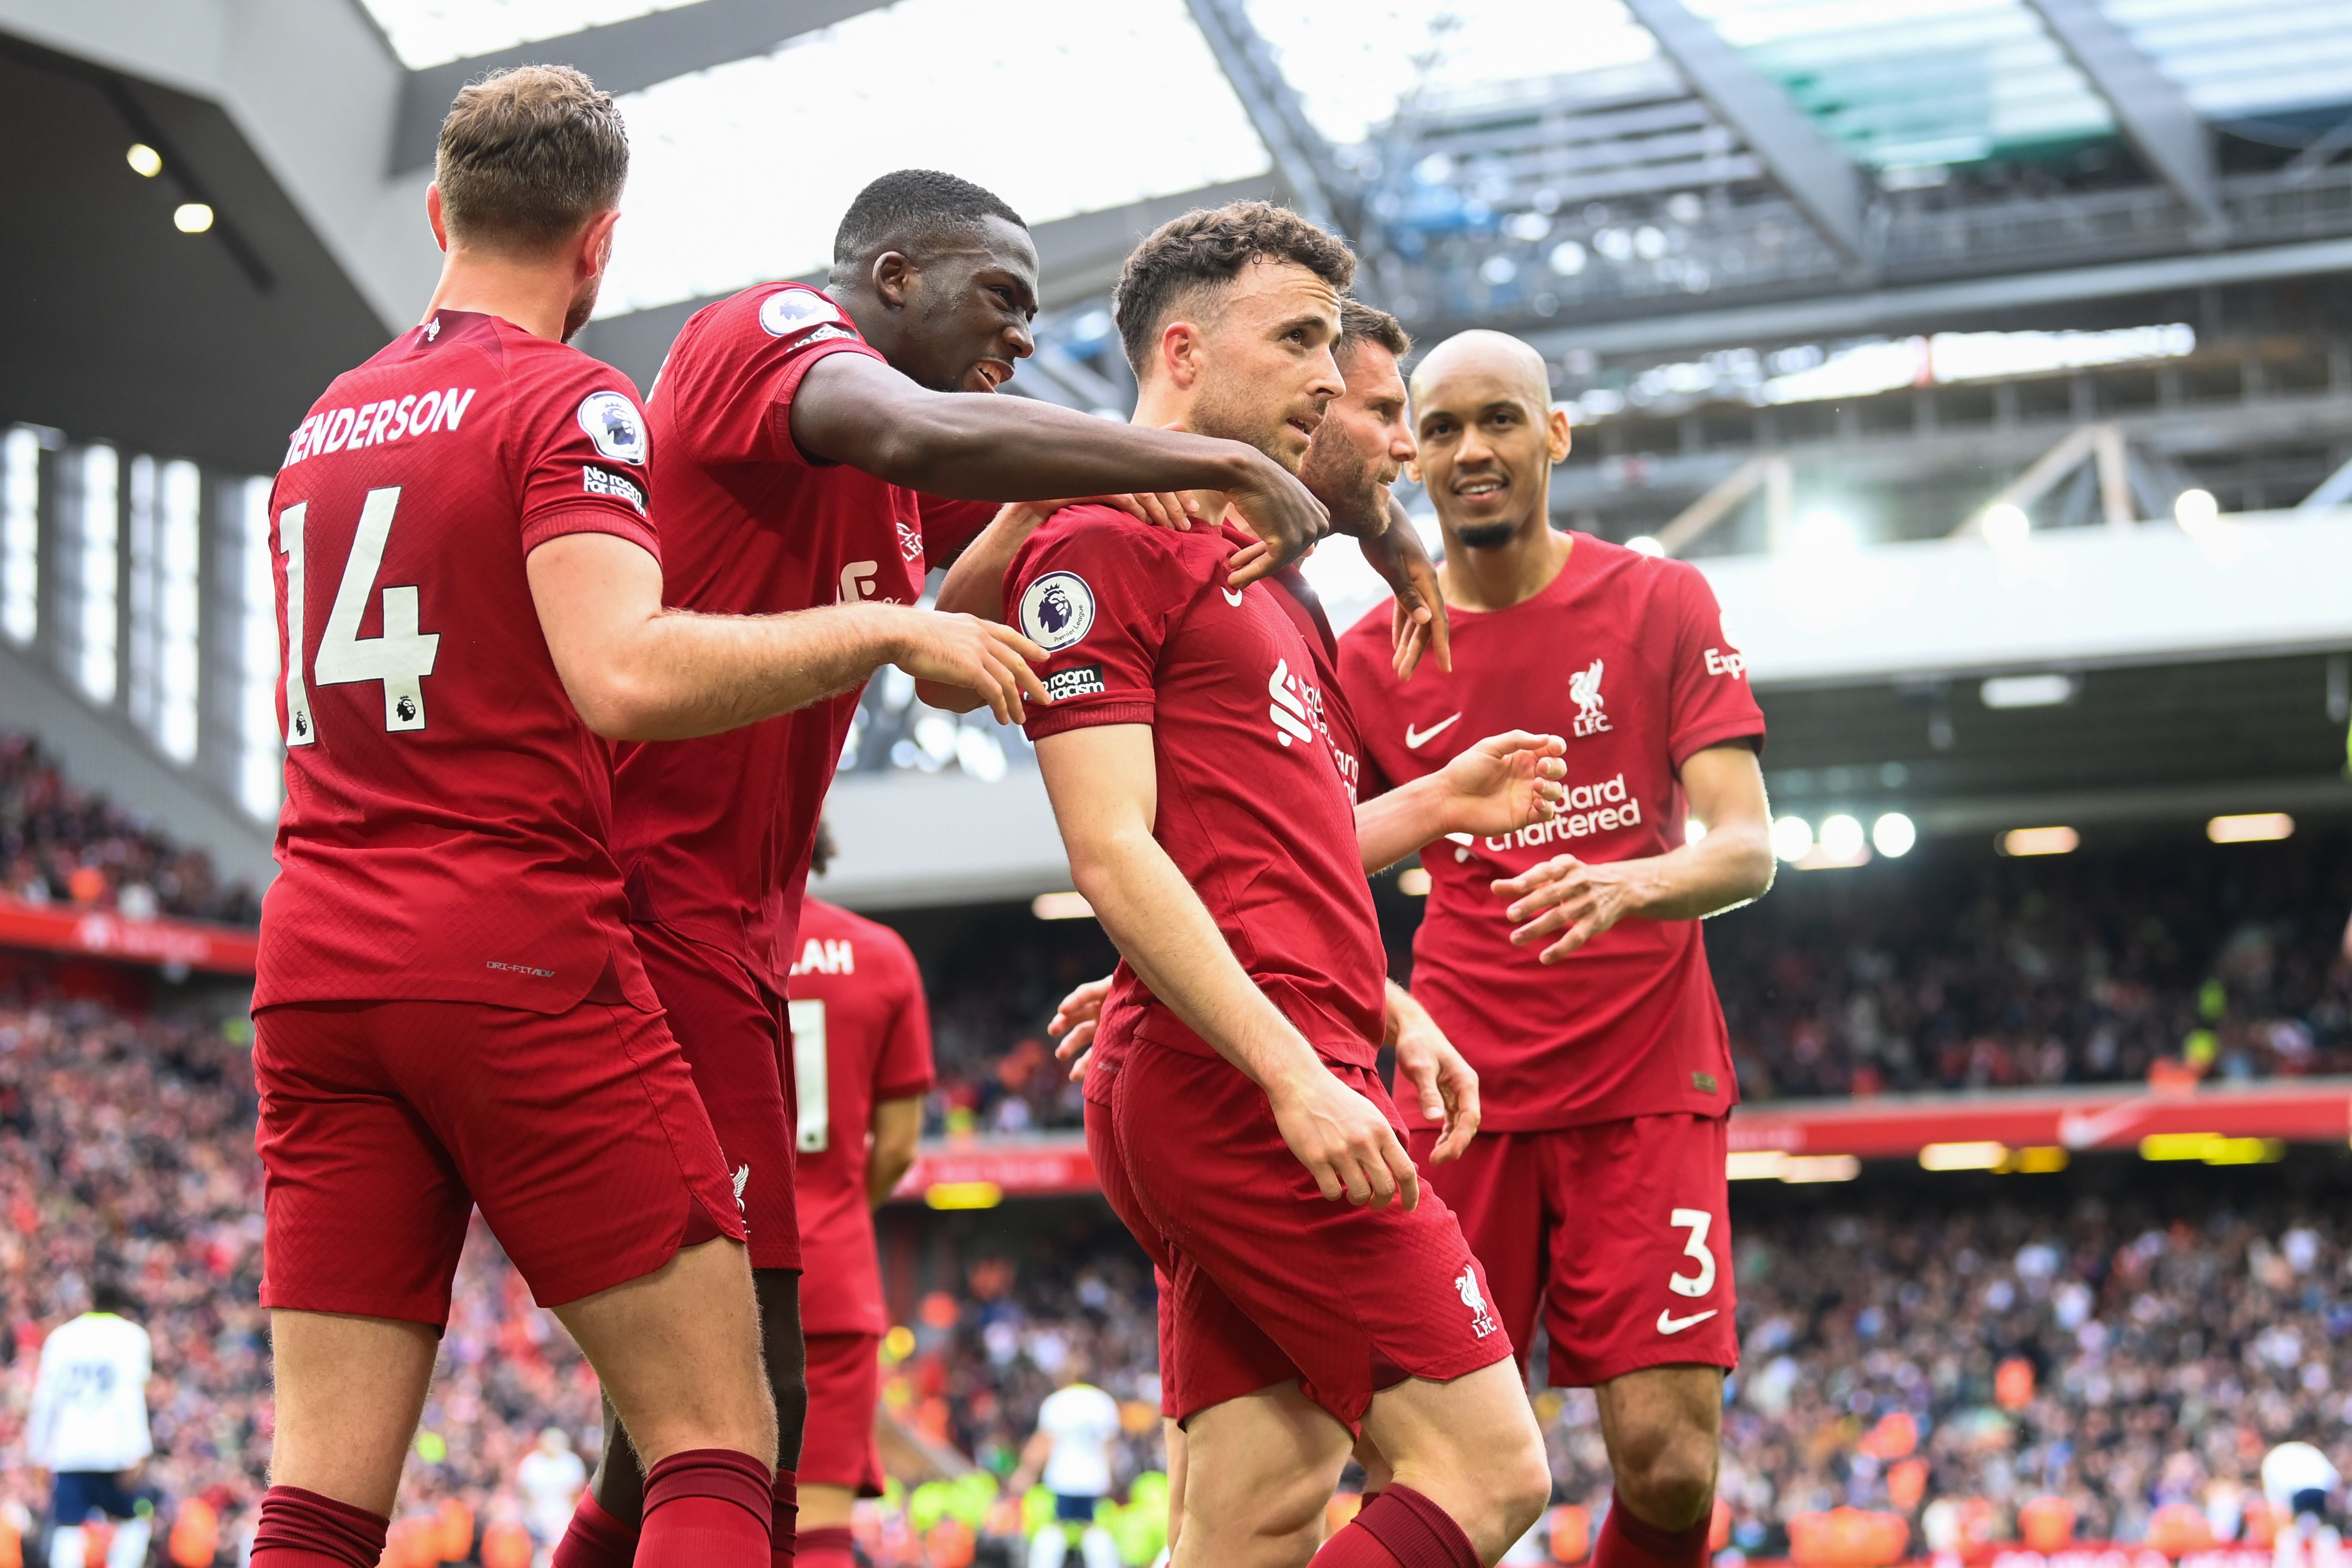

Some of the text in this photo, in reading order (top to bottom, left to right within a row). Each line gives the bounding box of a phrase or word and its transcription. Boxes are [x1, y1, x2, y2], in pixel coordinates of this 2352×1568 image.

[583, 465, 642, 505] No room
[583, 476, 609, 494] for
[279, 484, 441, 747] 14
[1054, 604, 1086, 643] Premier League
[1049, 681, 1105, 701] racism
[1050, 669, 1095, 690] room
[1552, 772, 1628, 814] dard
[1668, 1208, 1717, 1297] 3
